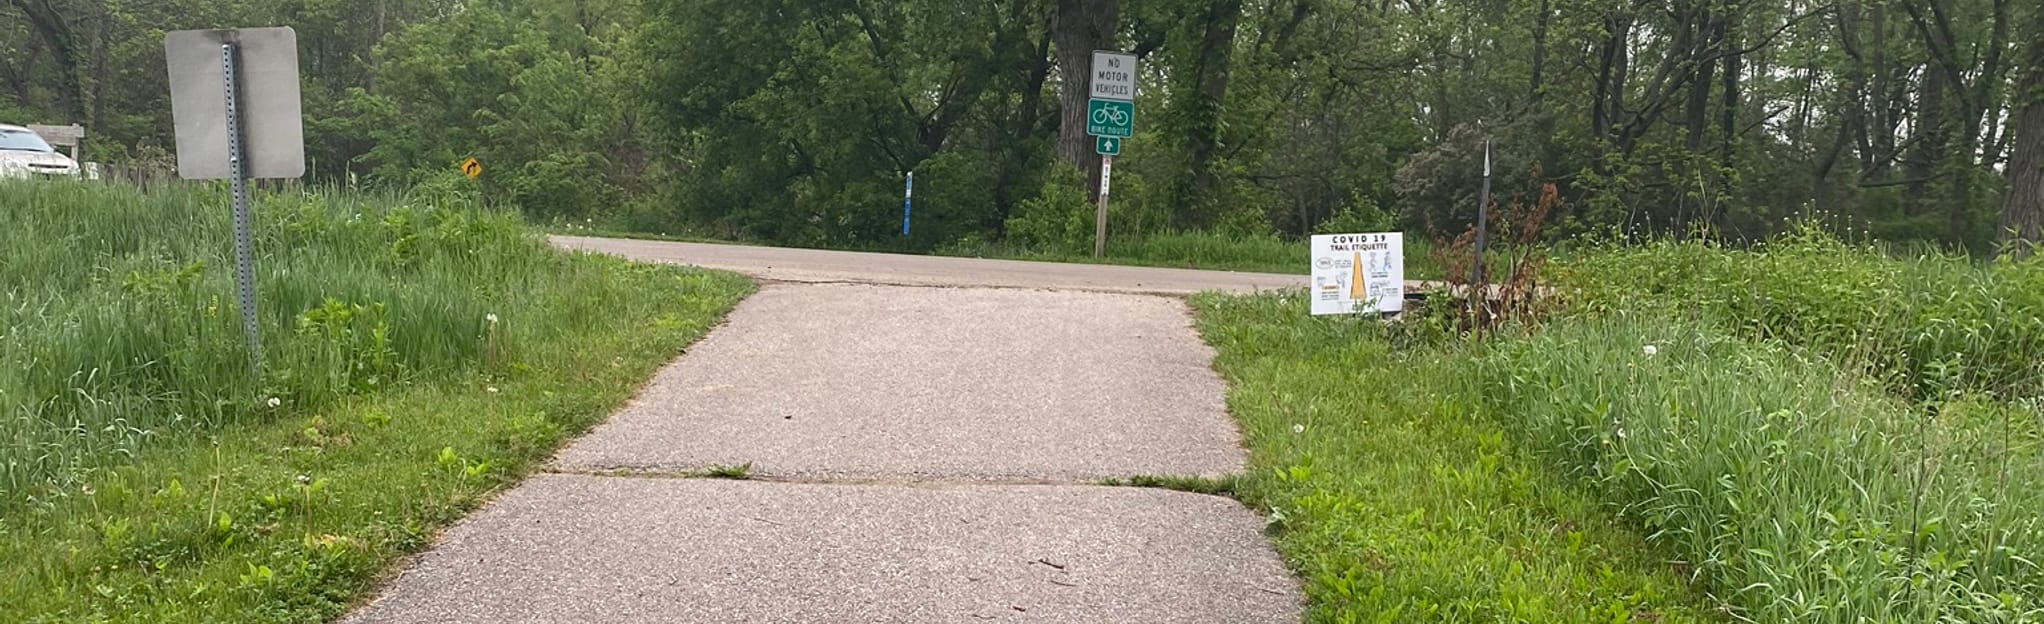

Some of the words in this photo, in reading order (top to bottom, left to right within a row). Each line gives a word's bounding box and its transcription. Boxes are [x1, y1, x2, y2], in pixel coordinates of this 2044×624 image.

[1108, 57, 1120, 68] NO
[1098, 71, 1128, 81] MOTOR
[1096, 84, 1128, 95] VEHICLES
[1091, 125, 1106, 134] BIKE
[1107, 126, 1129, 135] ROUTE
[1332, 235, 1367, 243] COVID
[1352, 243, 1388, 251] ETIQUETTE
